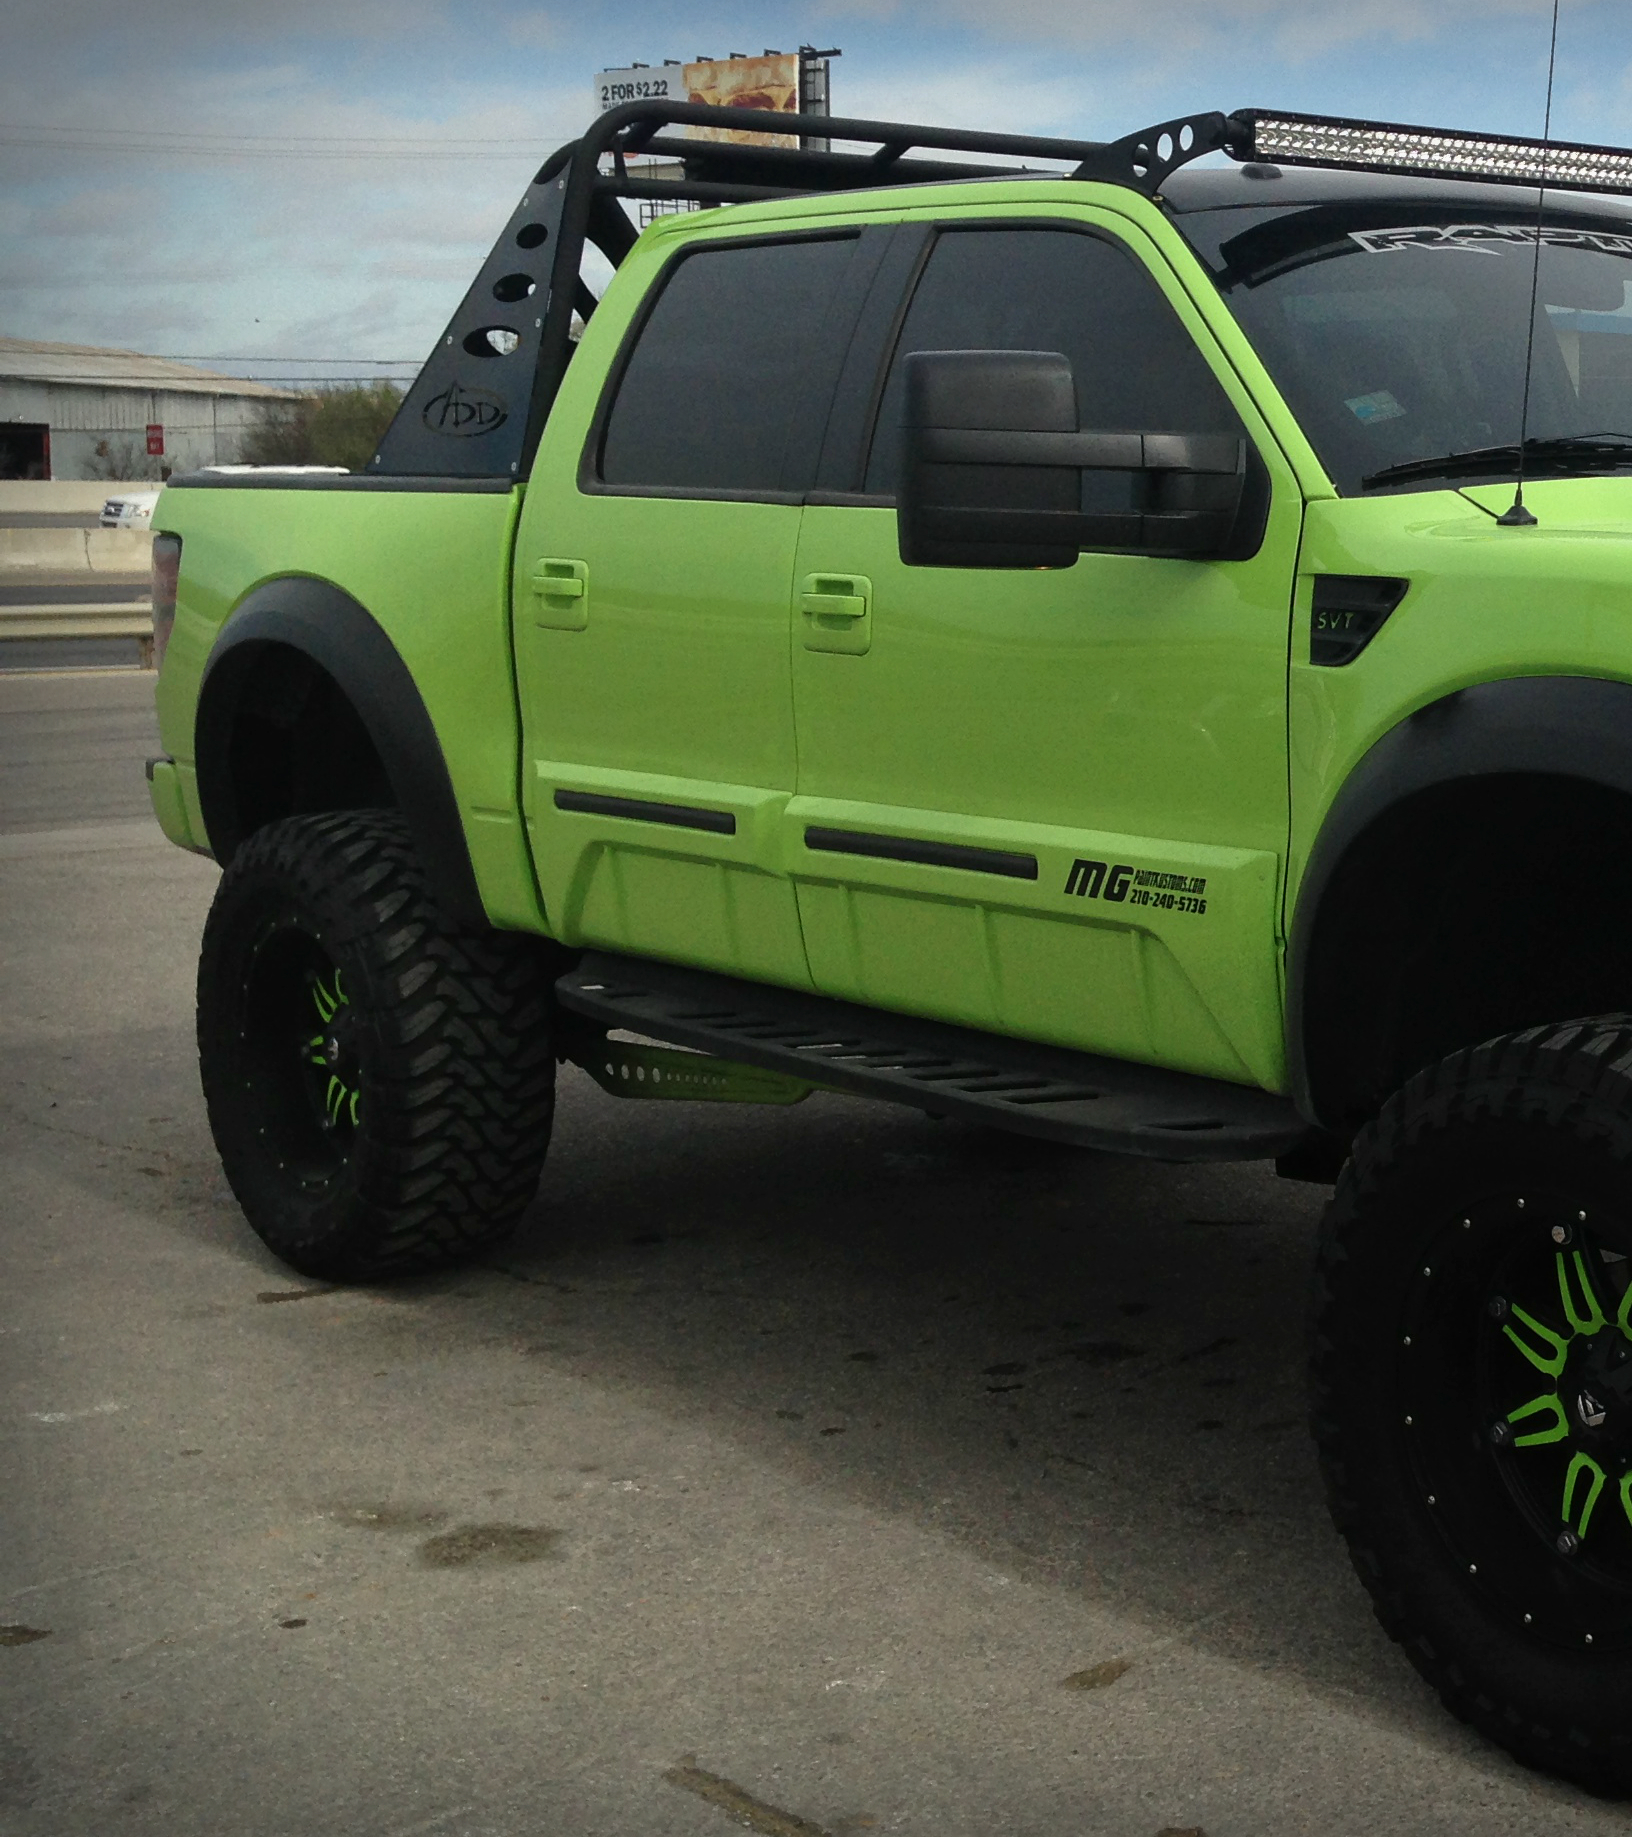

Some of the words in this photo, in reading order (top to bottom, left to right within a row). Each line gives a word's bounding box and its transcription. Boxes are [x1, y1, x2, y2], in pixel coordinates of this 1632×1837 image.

[601, 85, 610, 101] 2
[611, 83, 635, 101] FOR
[636, 80, 669, 98] $2.22
[1317, 611, 1354, 630] SVT
[1064, 858, 1135, 903] MG
[1129, 888, 1208, 915] 210-240-5736
